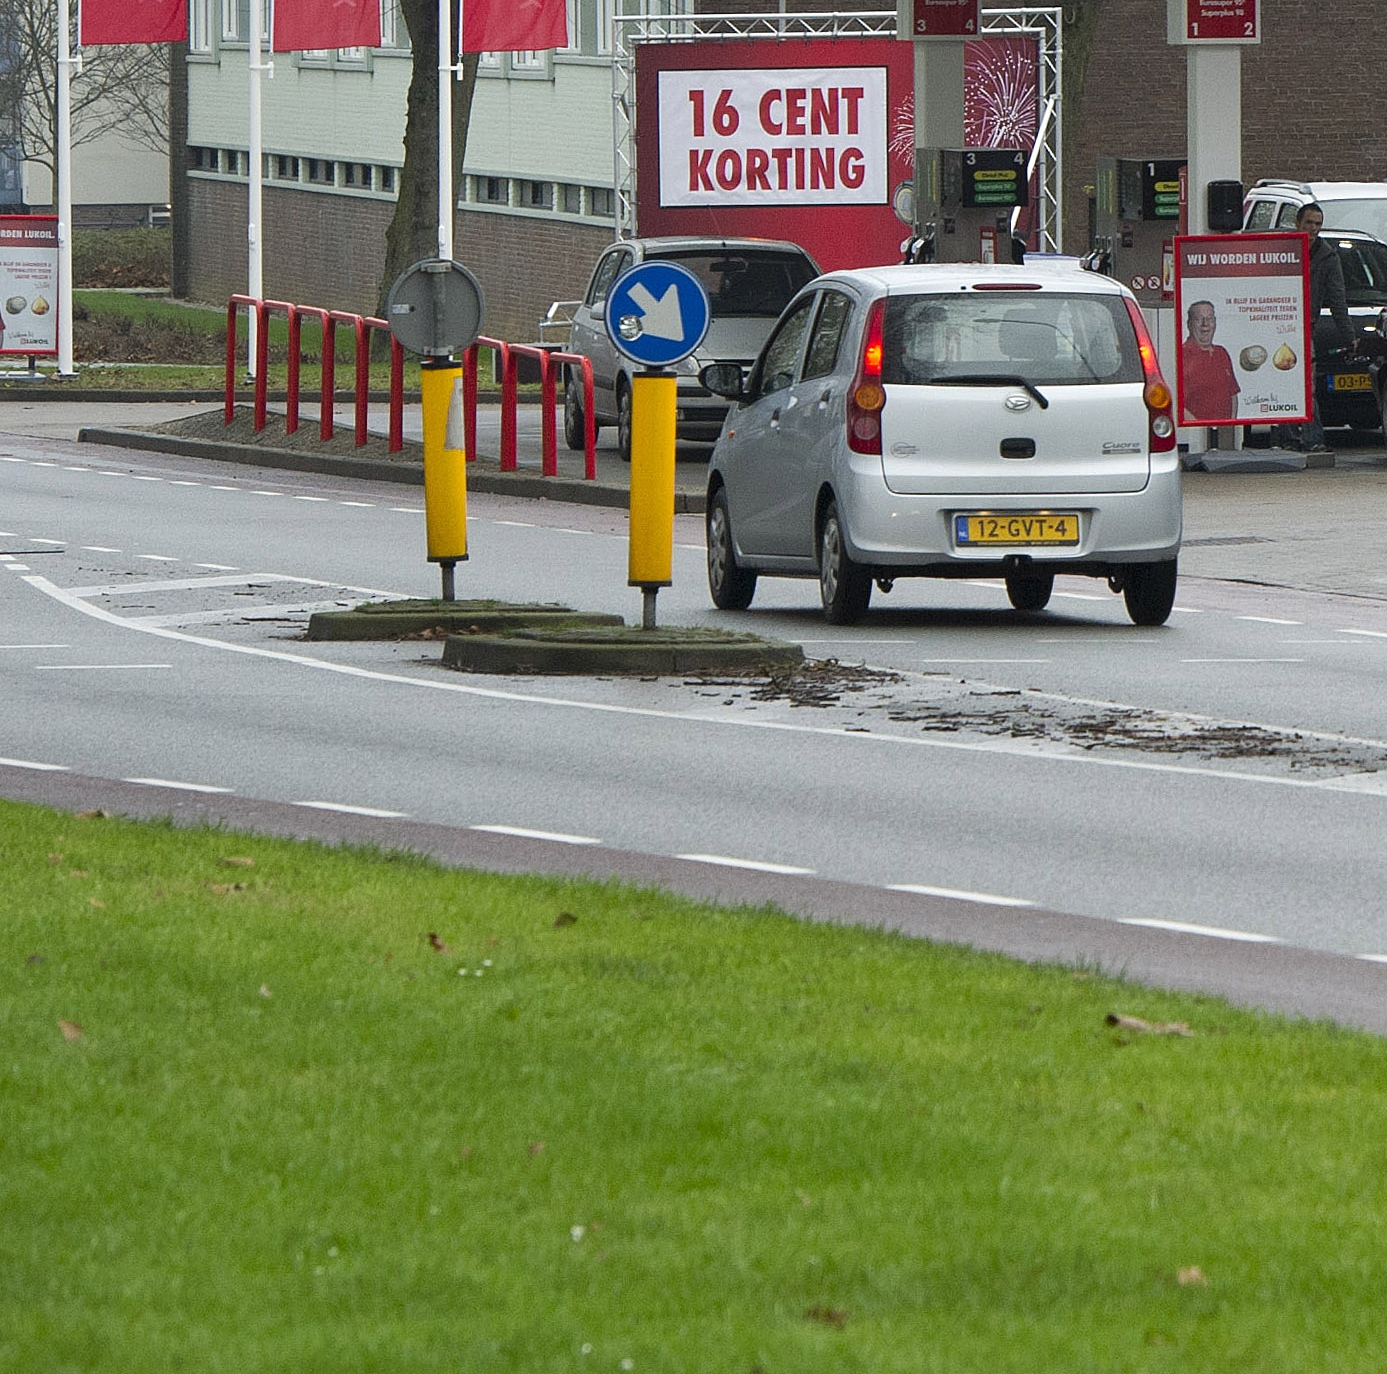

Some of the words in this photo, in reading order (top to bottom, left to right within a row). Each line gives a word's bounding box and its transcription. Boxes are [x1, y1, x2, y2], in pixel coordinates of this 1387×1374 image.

[916, 19, 926, 32] 3
[964, 18, 975, 32] 4
[1191, 22, 1199, 36] 1
[1243, 22, 1253, 35] 2
[689, 89, 740, 137] 16
[758, 86, 865, 137] CENT
[966, 152, 976, 165] 3
[1013, 152, 1024, 165] 4
[688, 145, 866, 193] KORTING
[1147, 162, 1155, 176] 1
[1187, 253, 1207, 265] WIJ
[1209, 253, 1256, 265] WORDEN
[1269, 404, 1298, 412] LUKOIL
[1102, 441, 1141, 449] Cuore
[978, 519, 1068, 537] 12-GVT-4
